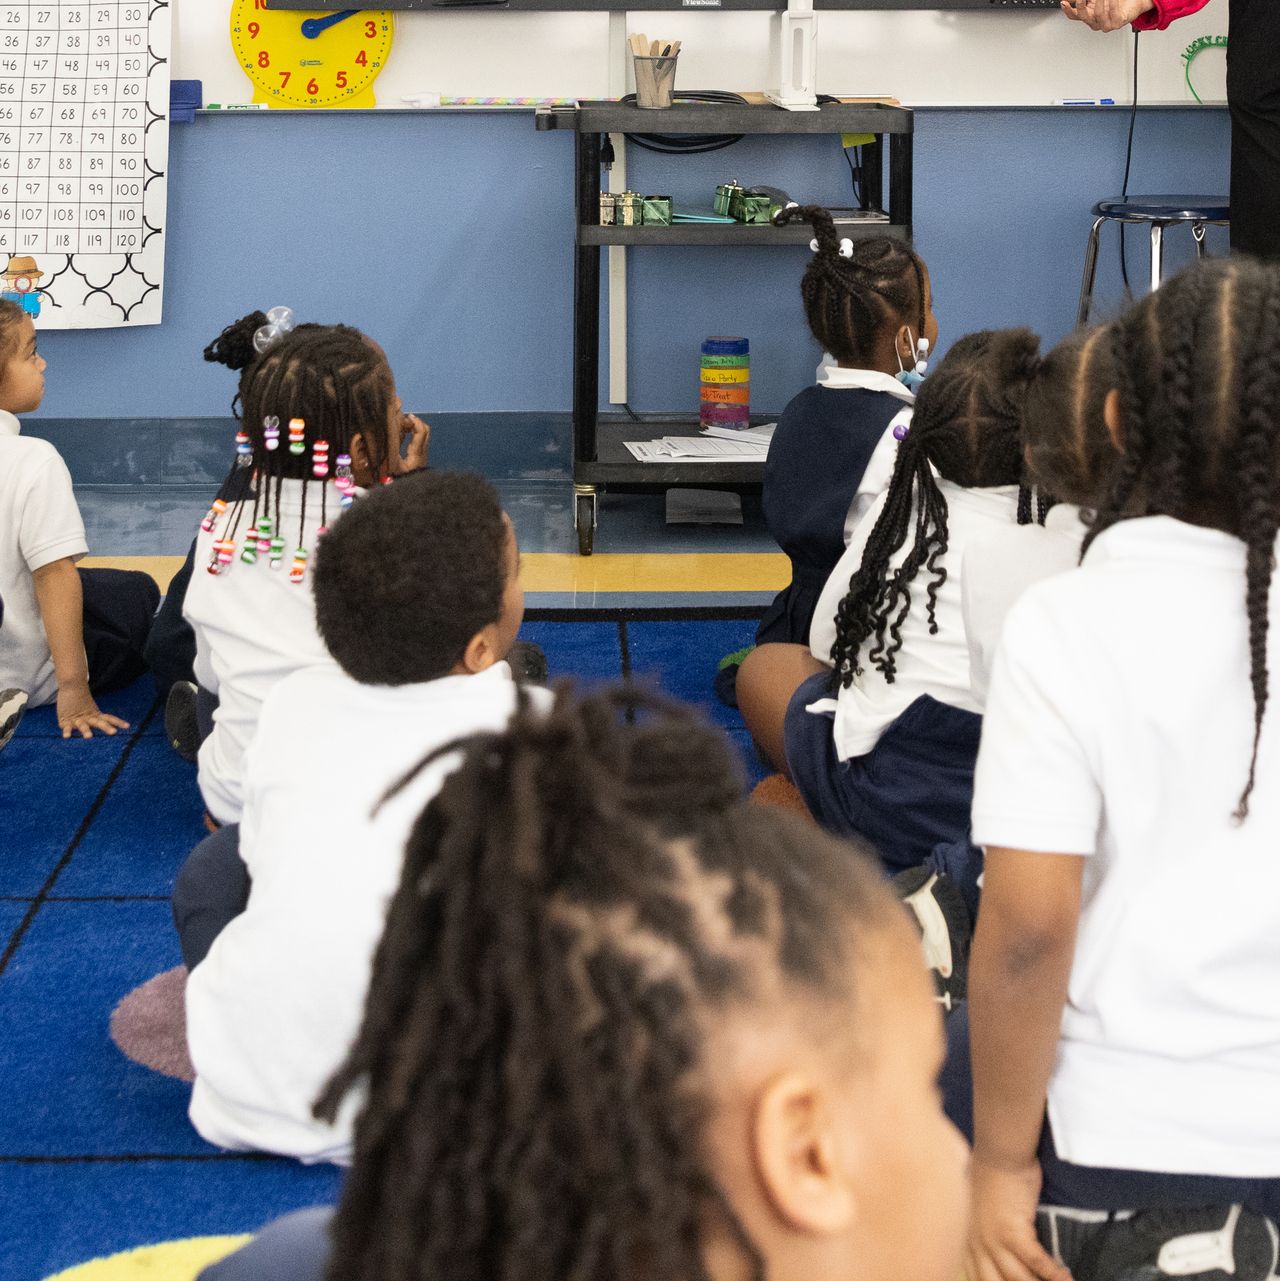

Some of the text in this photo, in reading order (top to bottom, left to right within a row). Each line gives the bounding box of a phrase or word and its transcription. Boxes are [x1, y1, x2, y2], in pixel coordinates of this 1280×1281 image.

[125, 9, 141, 21] 30
[248, 22, 259, 39] 9
[365, 21, 376, 38] 3
[125, 59, 140, 71] 50
[258, 51, 269, 68] 8
[355, 50, 367, 67] 4
[0, 83, 14, 94] 56
[307, 78, 318, 95] 6
[58, 184, 140, 196] 98 100
[117, 234, 136, 247] 120
